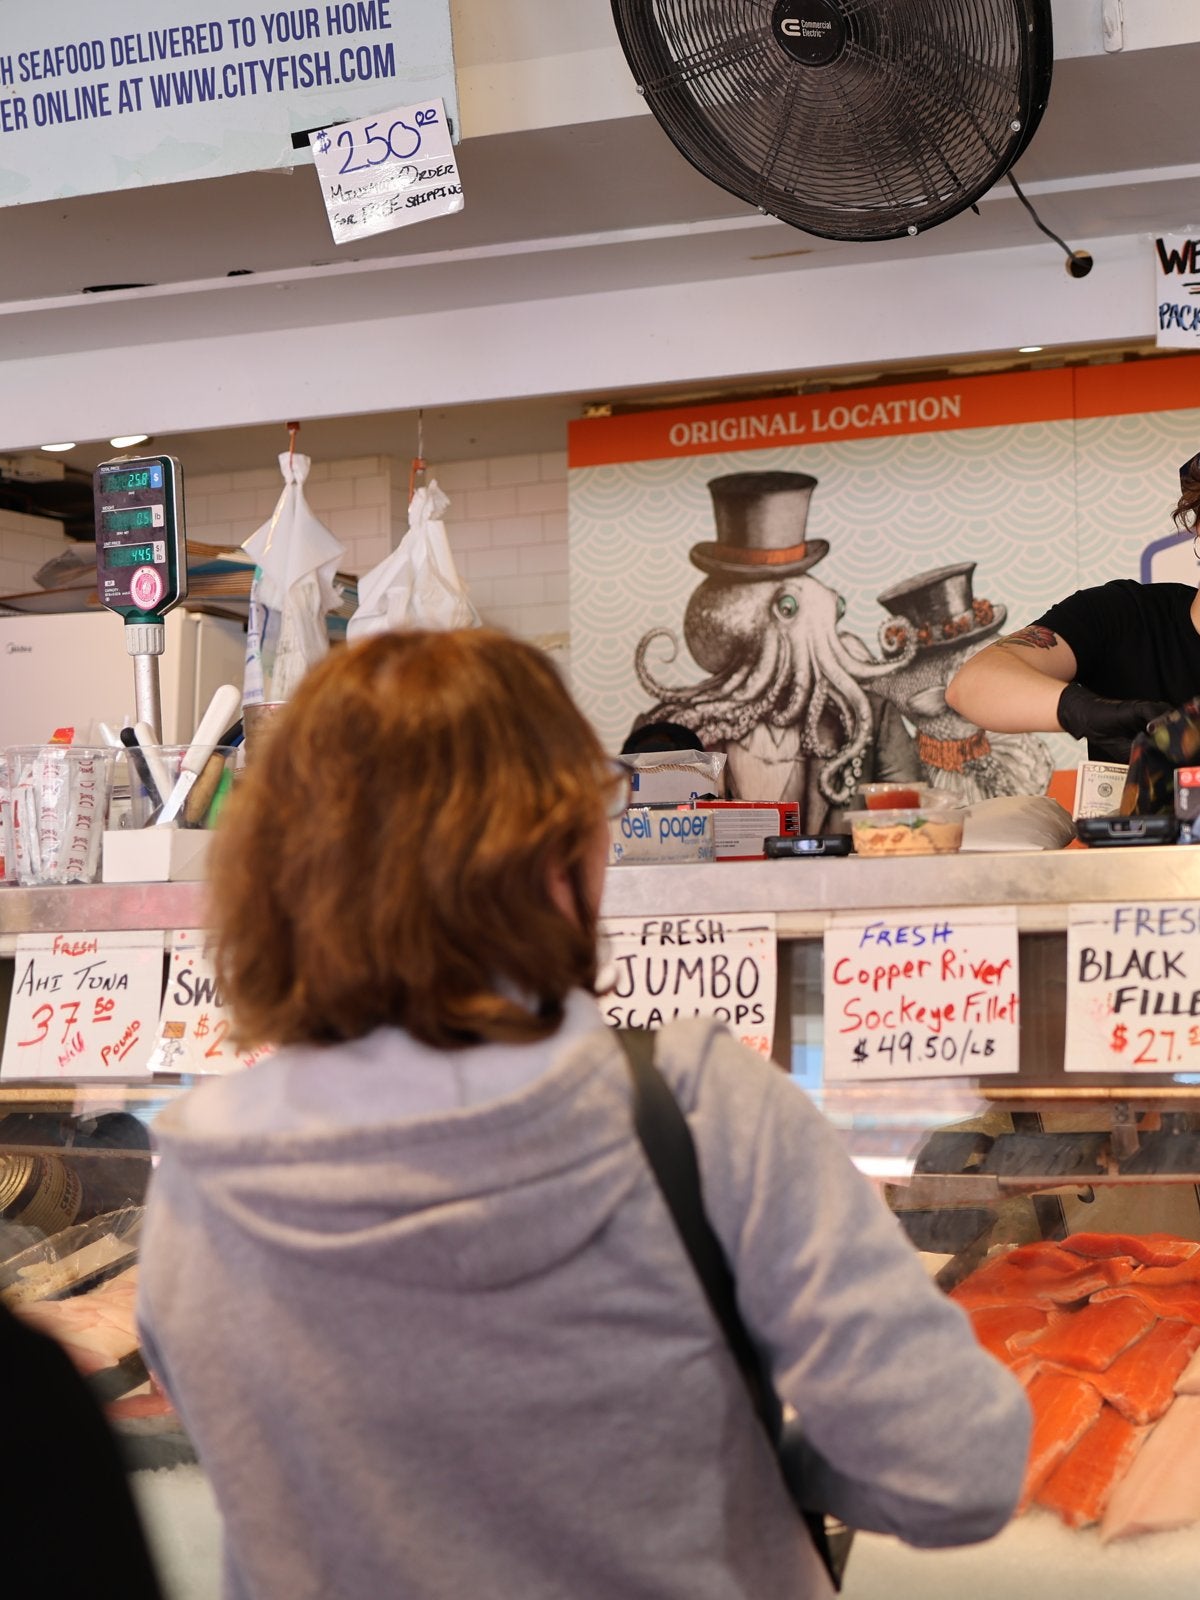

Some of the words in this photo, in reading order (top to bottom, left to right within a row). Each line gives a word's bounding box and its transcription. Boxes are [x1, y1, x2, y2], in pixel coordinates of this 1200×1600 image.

[0, 55, 14, 86] H
[18, 40, 106, 82] SEAFOOD
[110, 21, 224, 68] DELIVERED
[228, 17, 256, 49] TO
[261, 8, 320, 44] YOUR
[326, 0, 392, 36] HOME
[801, 20, 832, 30] Commercial
[0, 97, 29, 133] ER
[32, 83, 112, 127] ONLINE
[119, 77, 144, 115] AT
[150, 43, 396, 108] WWW.CITYFISH.COM
[405, 184, 463, 209] SHIPPING
[669, 410, 806, 447] ORIGINAL
[811, 395, 963, 432] LOCATION
[621, 811, 652, 839] deli
[660, 815, 708, 844] paper
[53, 935, 98, 956] FRESH
[641, 918, 725, 946] FRESH
[859, 921, 955, 948] FRESH
[614, 954, 760, 1000] JUMBO
[833, 957, 931, 993] Copper
[941, 949, 1012, 987] River
[1078, 947, 1187, 984] BLACK
[839, 995, 956, 1034] Sockeye
[963, 990, 1020, 1026] Fillet
